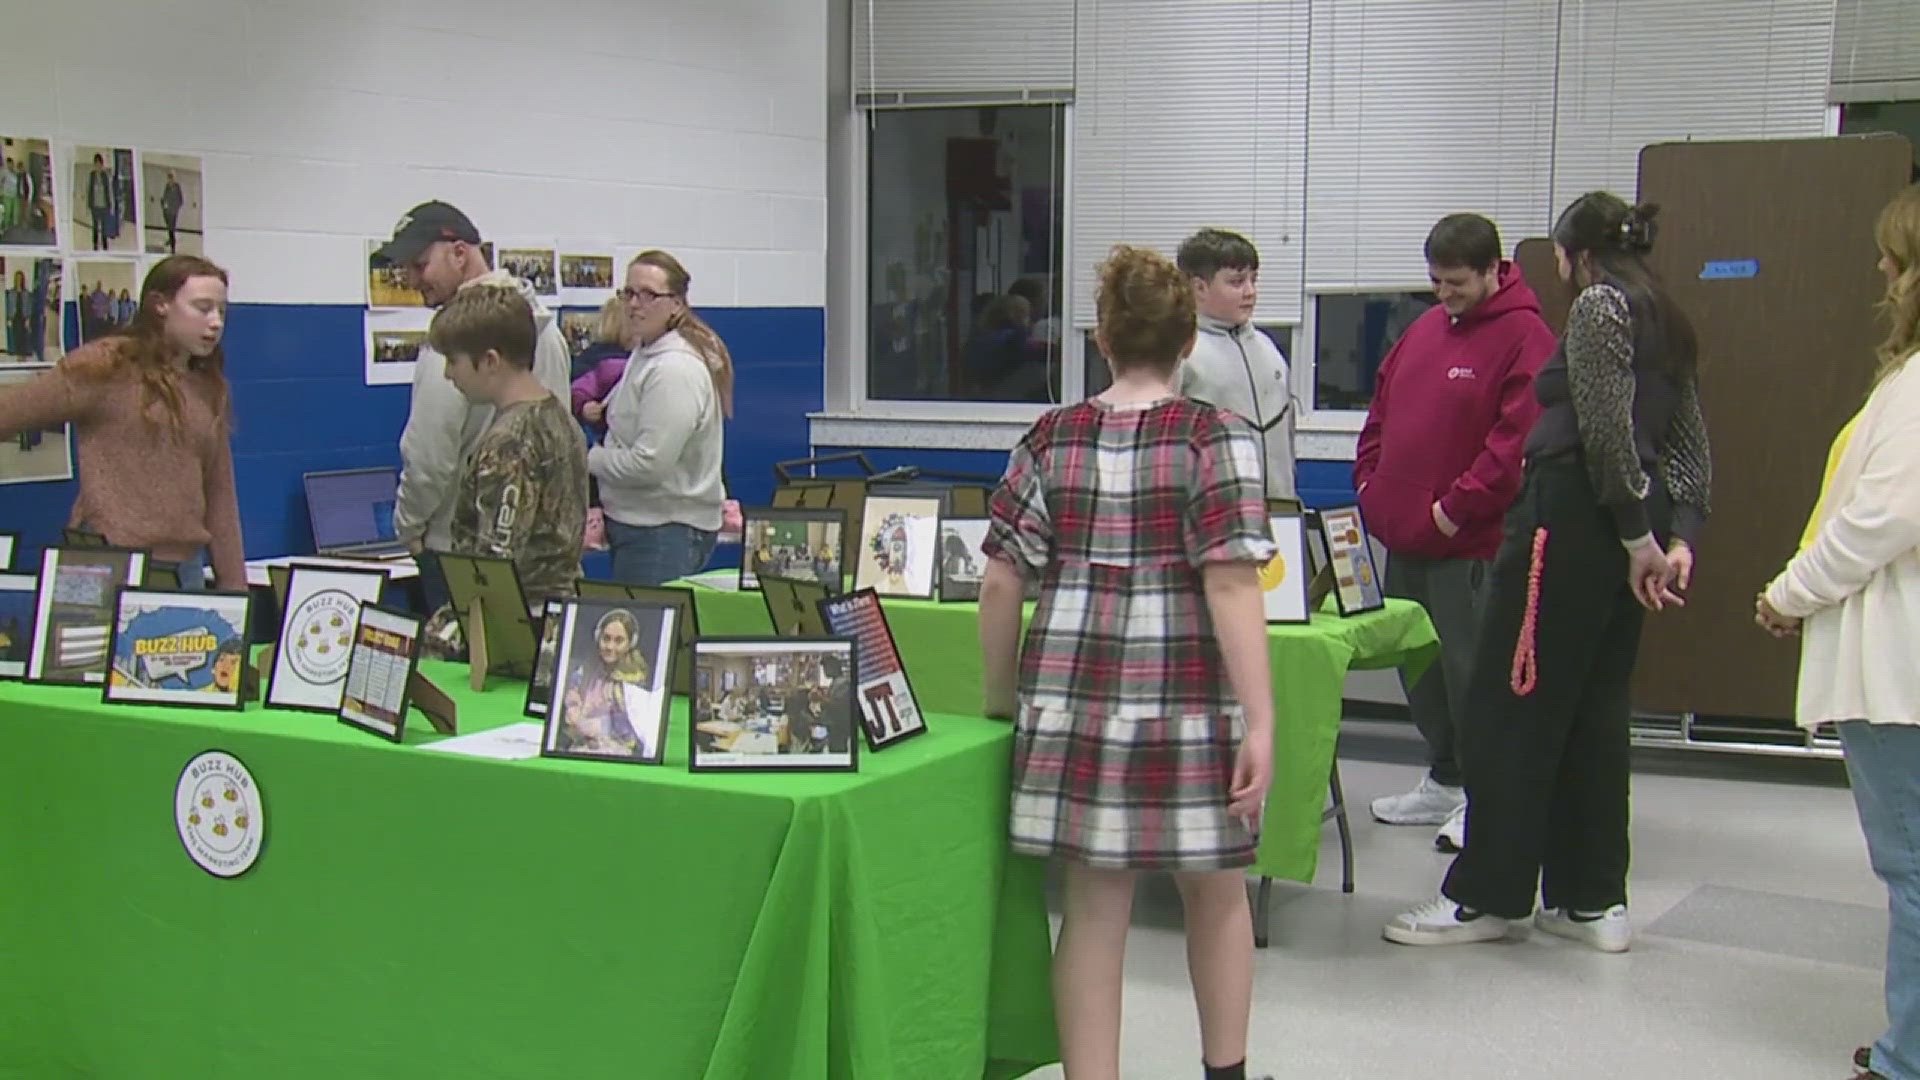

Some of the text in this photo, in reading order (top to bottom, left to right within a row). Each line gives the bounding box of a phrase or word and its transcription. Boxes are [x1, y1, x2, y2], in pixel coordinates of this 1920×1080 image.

[306, 597, 355, 615] BUZZ HUB
[135, 635, 218, 655] BUZZ HUB
[864, 681, 903, 739] JT
[191, 760, 249, 789] BUZZ HUB
